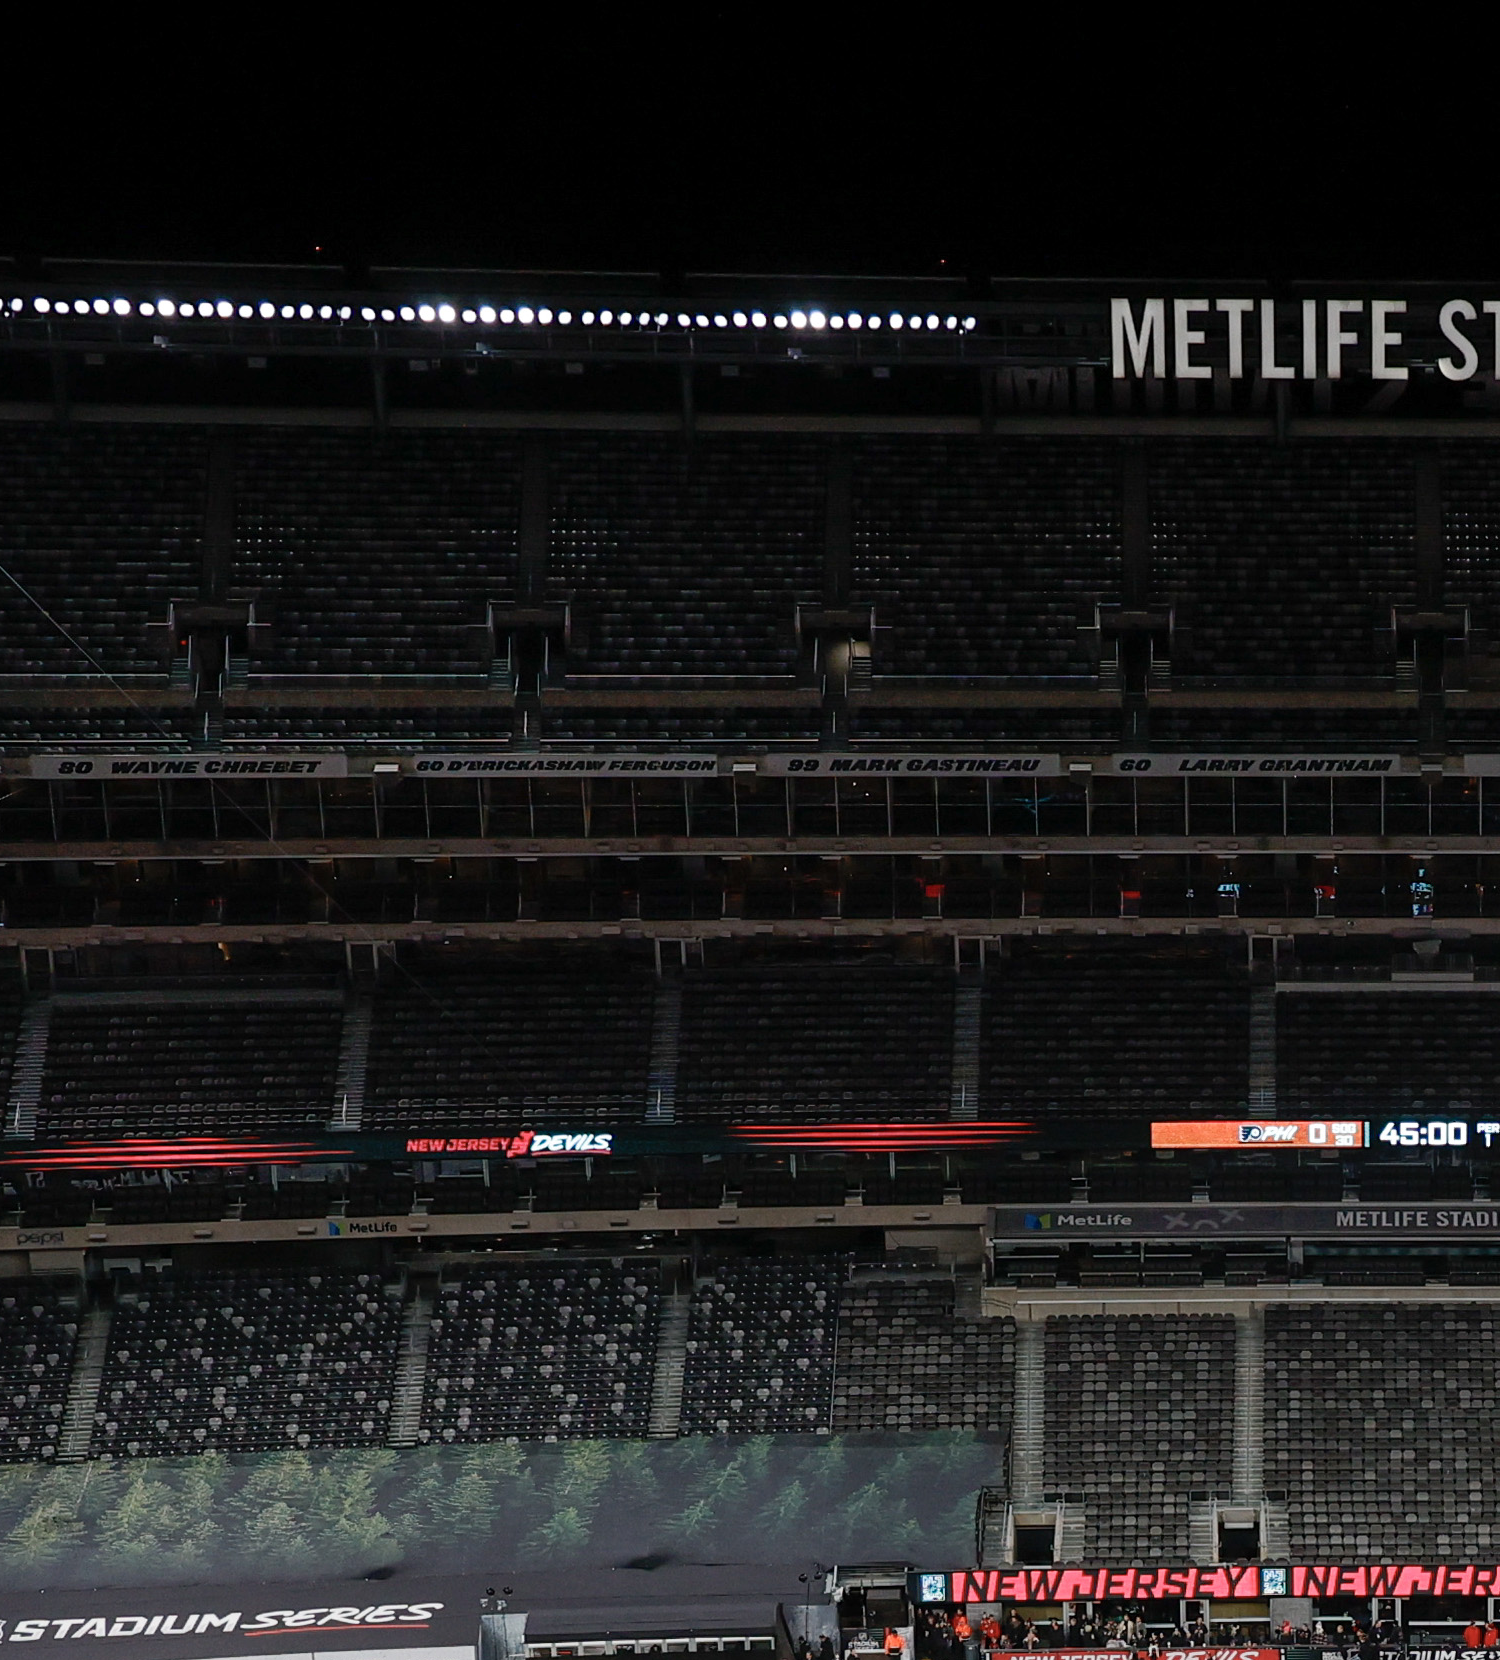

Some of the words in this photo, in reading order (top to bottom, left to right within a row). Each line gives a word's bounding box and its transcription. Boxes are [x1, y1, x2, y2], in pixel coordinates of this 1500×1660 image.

[1111, 298, 1408, 380] METLIFE
[57, 760, 94, 775] 80
[111, 760, 199, 775] WAYNE
[203, 759, 322, 774] CHREBET
[1262, 1126, 1295, 1141] PHI
[1308, 1123, 1327, 1144] 0
[1379, 1122, 1468, 1146] 45:00
[1476, 1122, 1500, 1135] PER
[407, 1138, 445, 1152] NEW
[446, 1137, 510, 1151] JERSEY
[530, 1134, 612, 1151] DEVILS
[1334, 1134, 1353, 1146] 30
[1057, 1213, 1133, 1227] MetLife
[1336, 1211, 1428, 1228] METLIFE
[8, 1612, 242, 1642] STADIUM
[240, 1602, 445, 1631] SERIES
